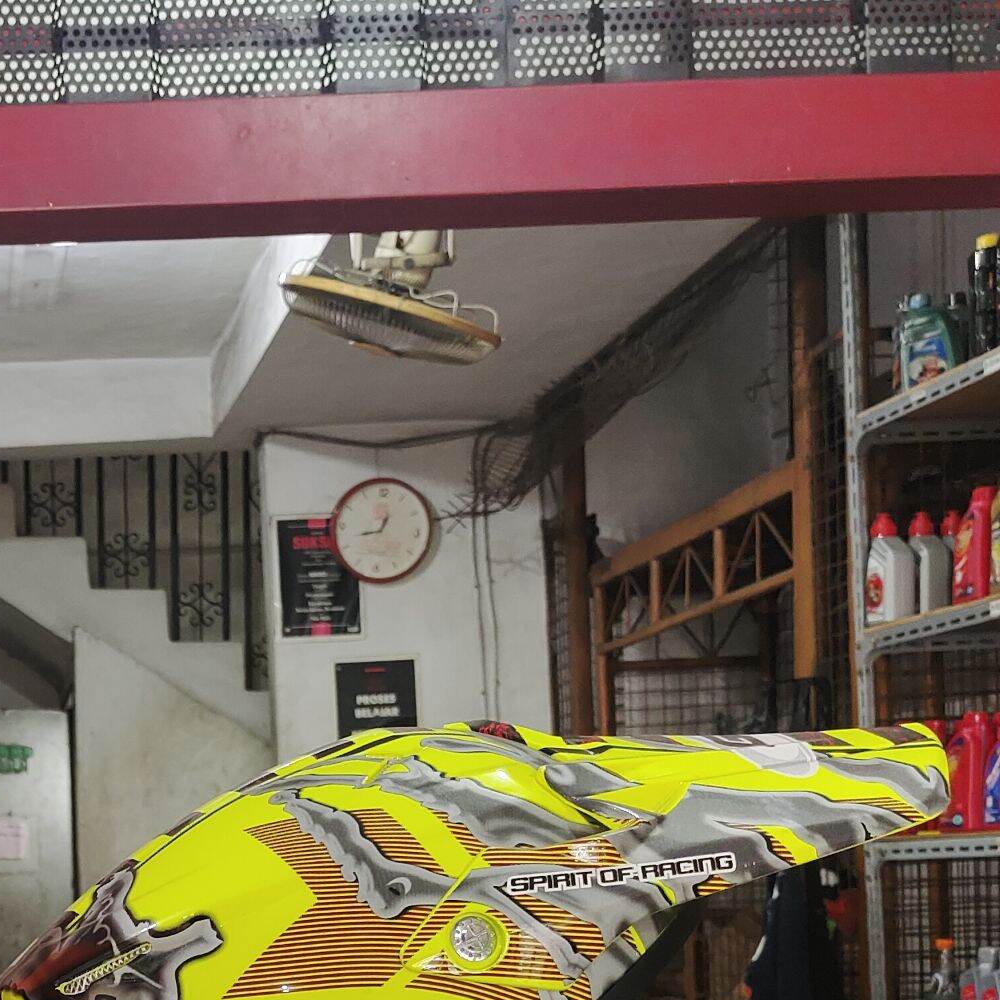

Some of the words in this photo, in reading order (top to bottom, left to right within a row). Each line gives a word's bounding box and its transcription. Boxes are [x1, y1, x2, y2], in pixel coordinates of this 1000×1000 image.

[510, 870, 592, 892] SPIRIT
[599, 867, 633, 884] OF
[641, 854, 734, 880] RACING
